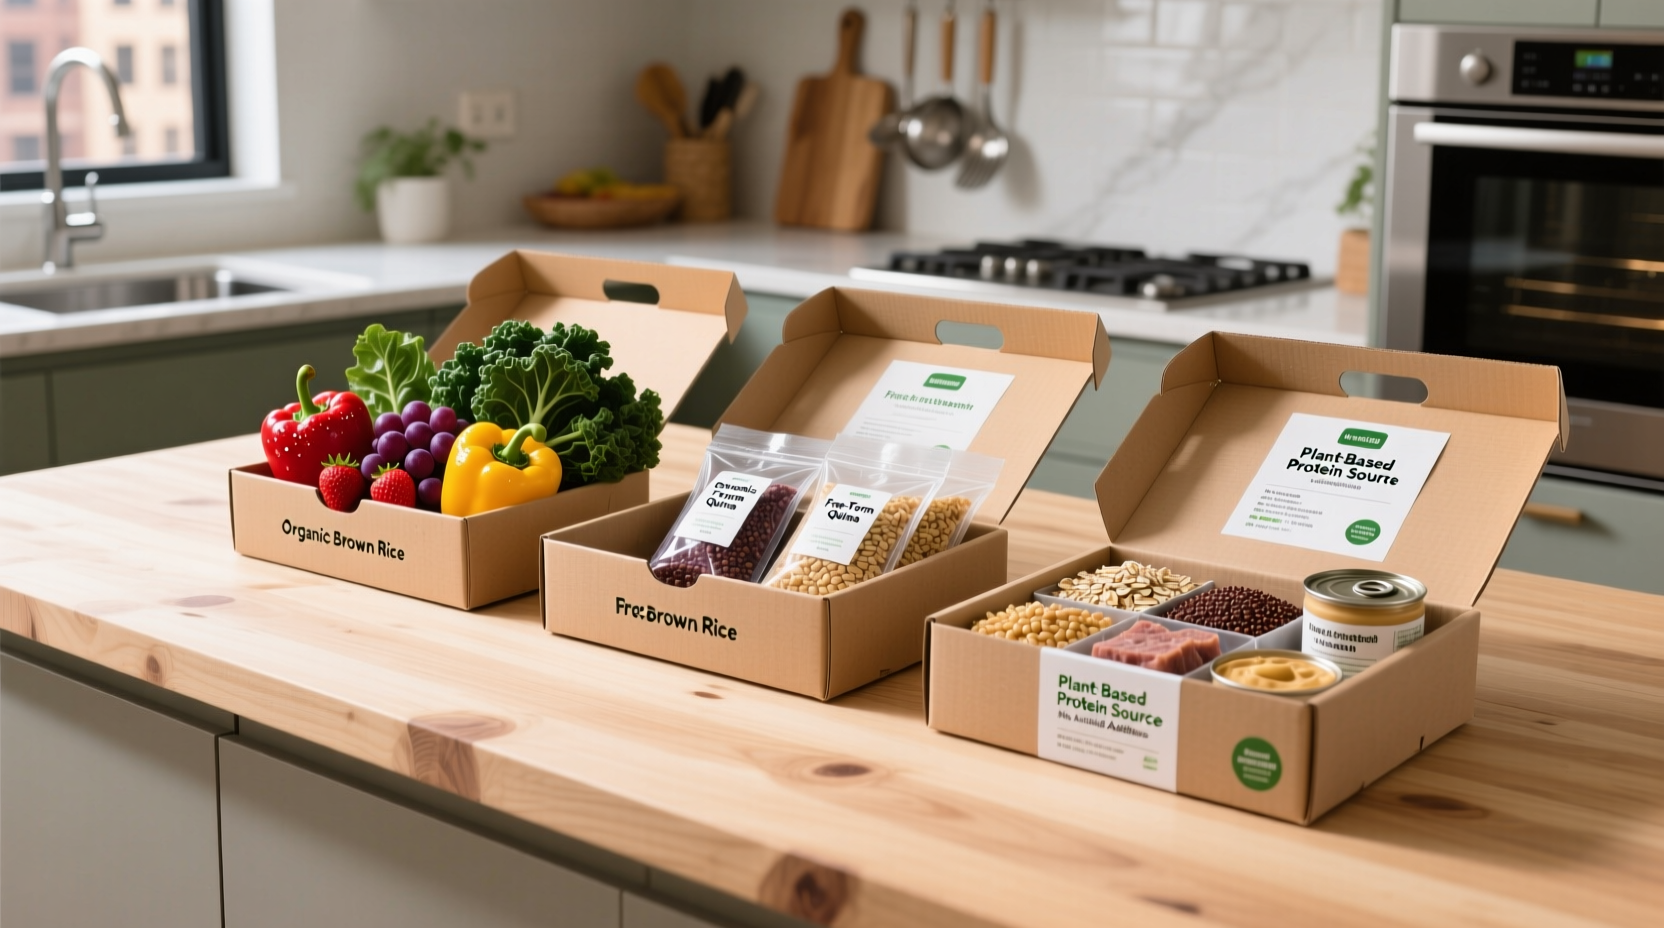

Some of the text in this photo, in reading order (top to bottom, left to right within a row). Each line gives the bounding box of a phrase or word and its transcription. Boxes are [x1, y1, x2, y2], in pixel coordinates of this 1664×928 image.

[1286, 458, 1343, 478] Protein
[1299, 446, 1396, 471] Plant-Based
[281, 518, 405, 561] Organic Brown Rice
[702, 615, 738, 641] Rice
[1101, 682, 1147, 707] Based
[1057, 690, 1107, 716] Protein
[1111, 702, 1163, 727] Source
